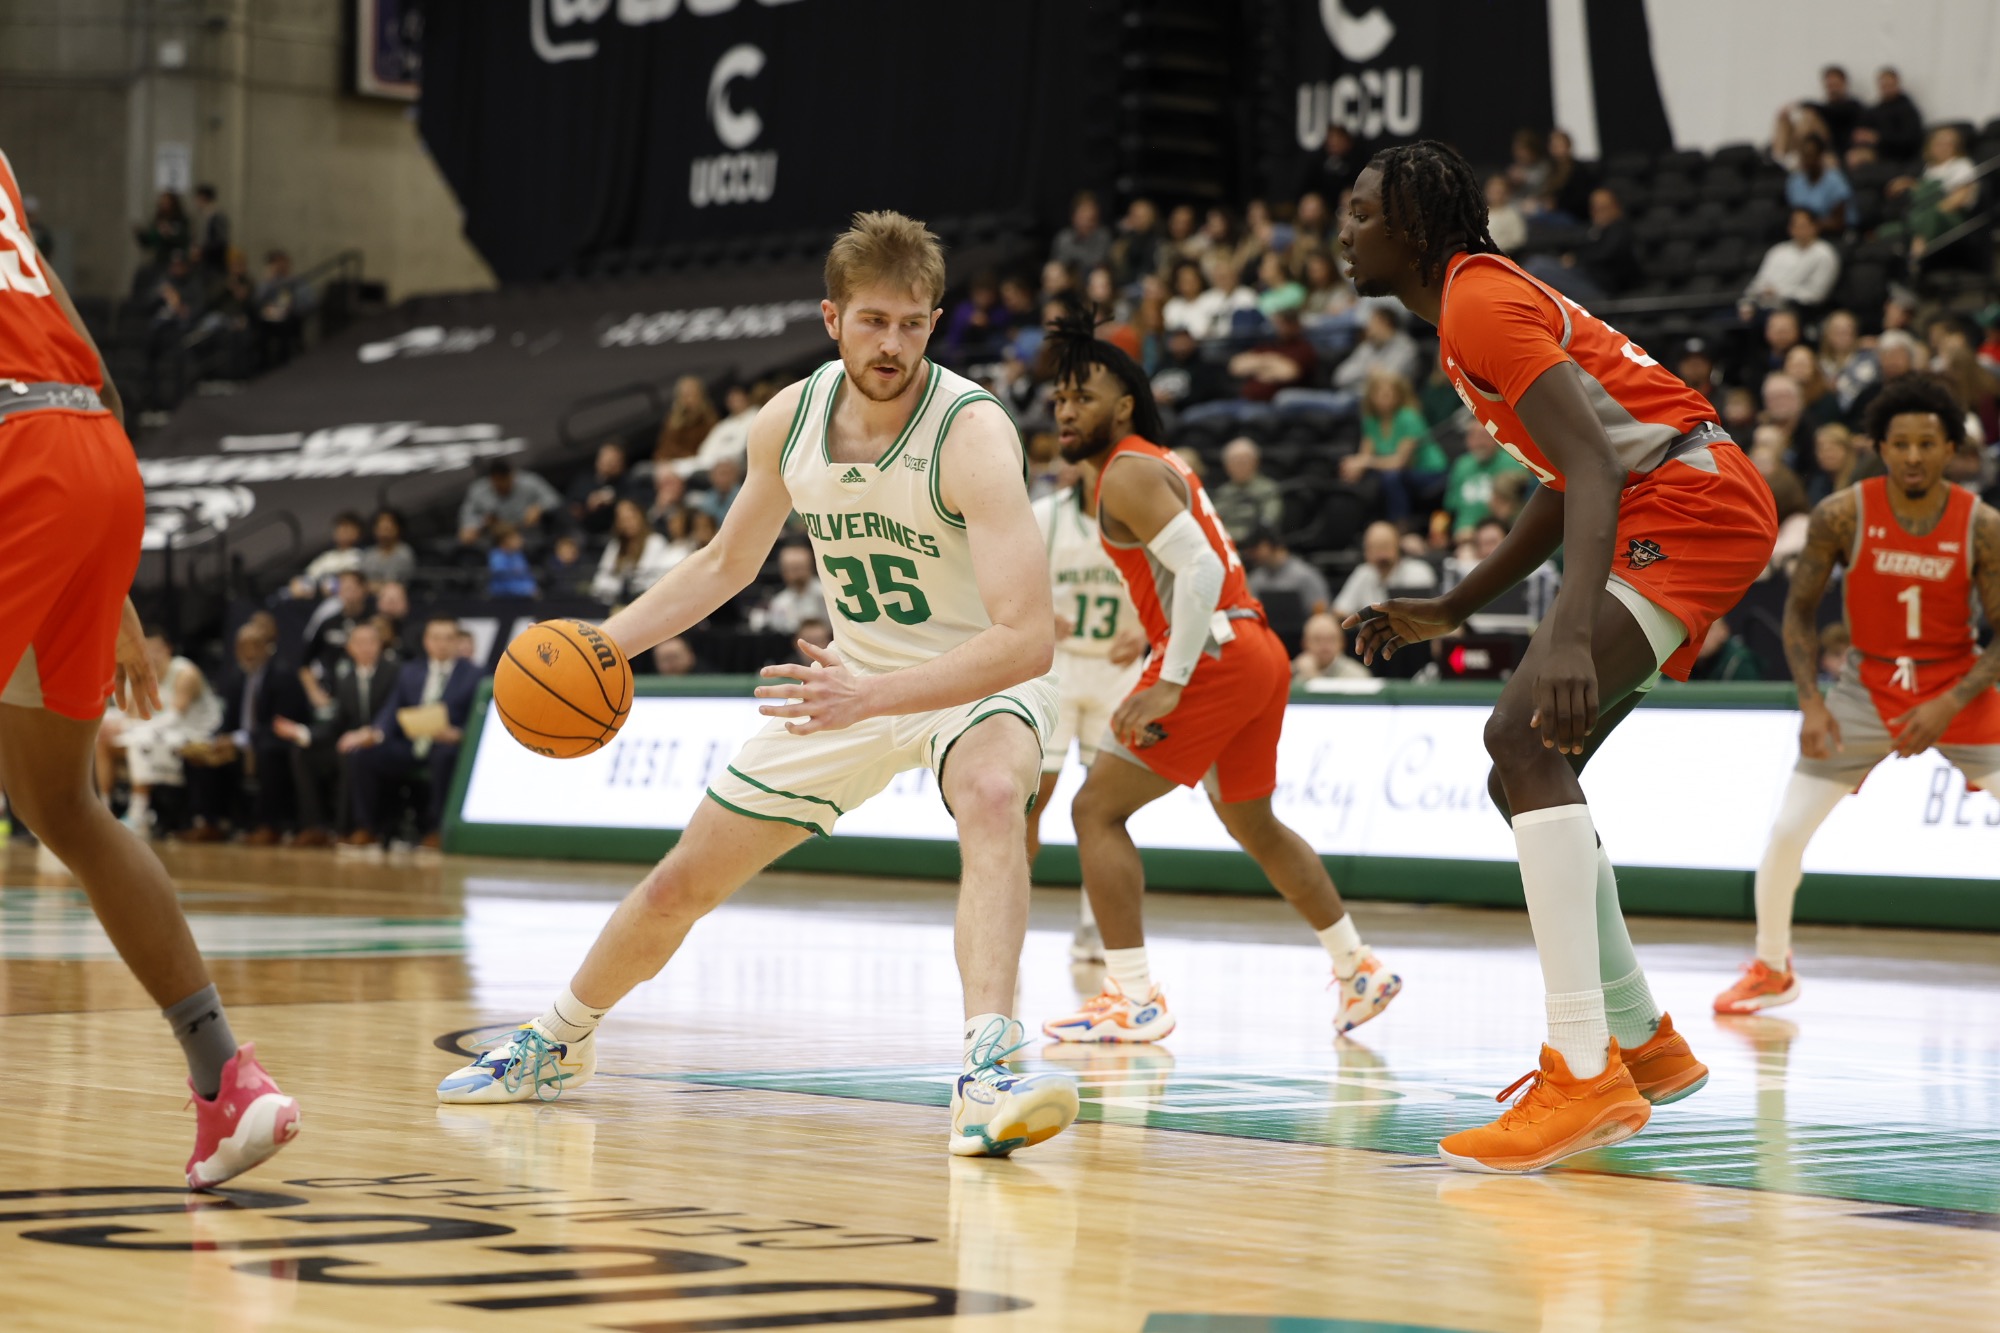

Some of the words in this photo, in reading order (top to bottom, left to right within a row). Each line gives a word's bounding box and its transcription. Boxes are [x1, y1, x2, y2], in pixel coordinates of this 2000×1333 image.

[1296, 65, 1423, 151] UCCU
[689, 150, 778, 208] UCCU
[822, 553, 932, 625] 35
[1073, 593, 1119, 639] 13
[1897, 585, 1922, 640] 1
